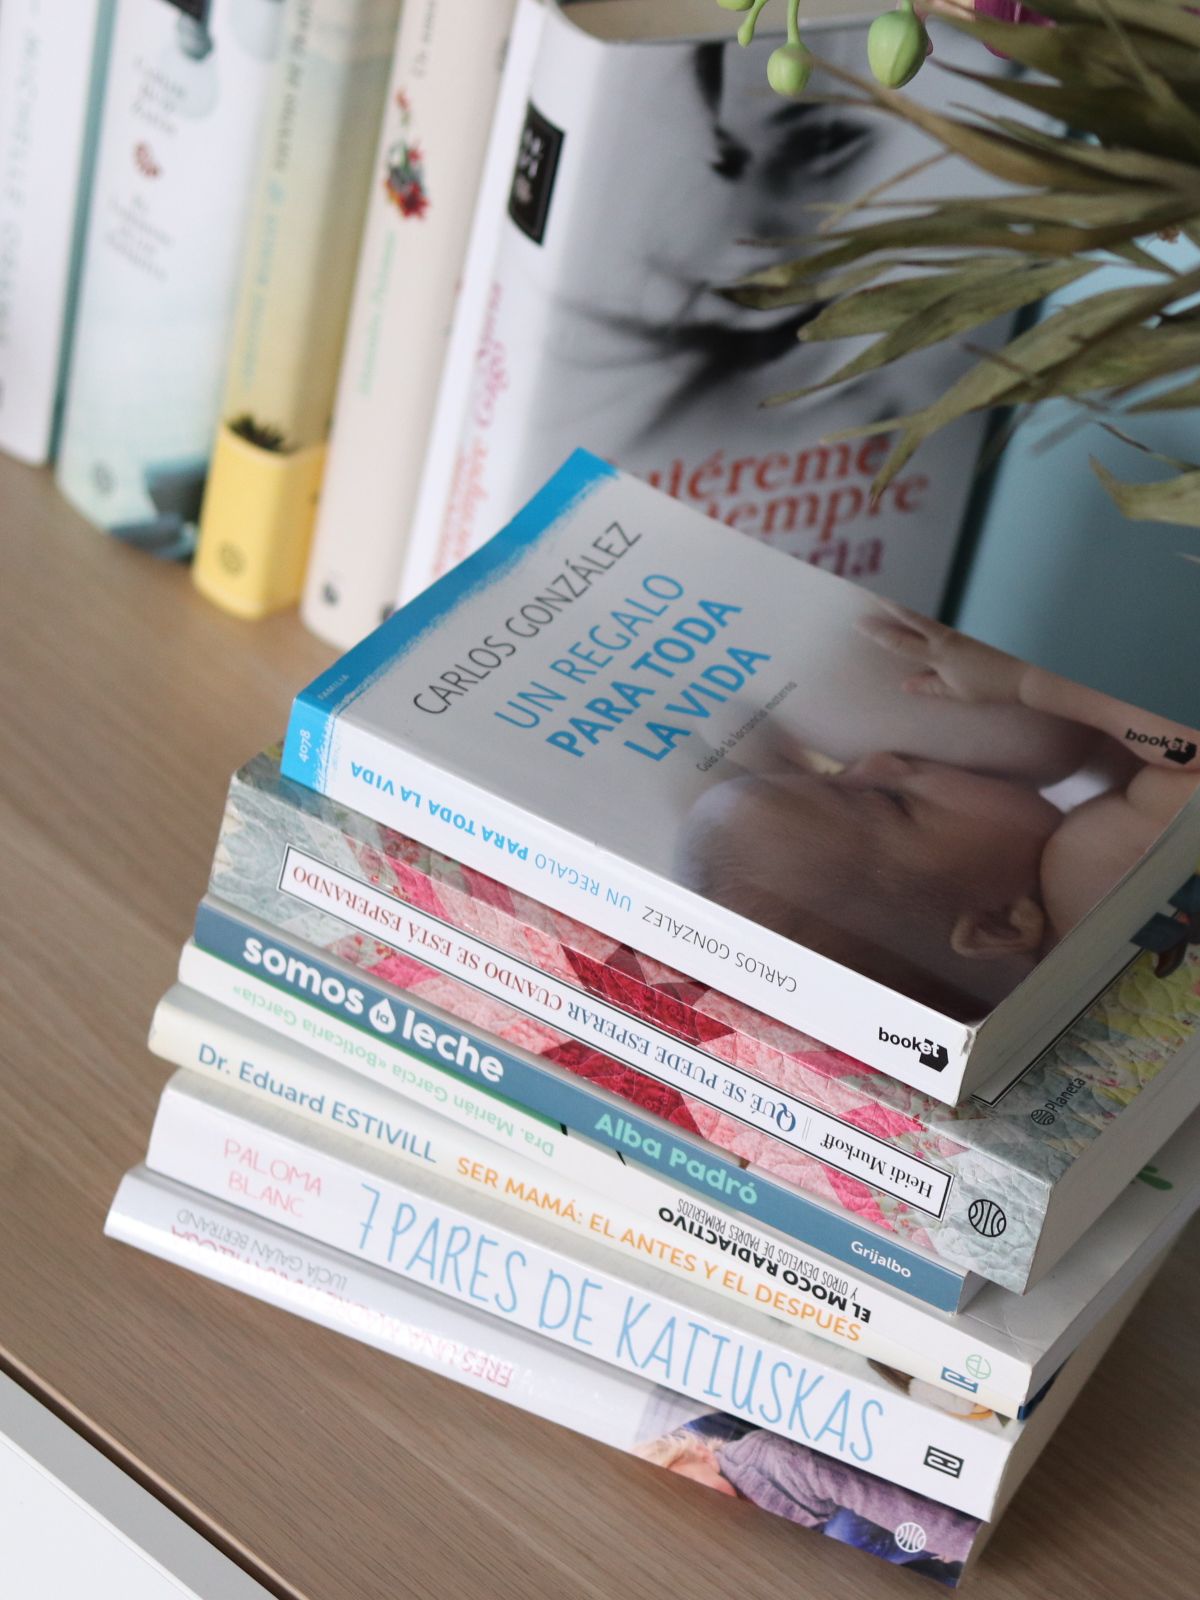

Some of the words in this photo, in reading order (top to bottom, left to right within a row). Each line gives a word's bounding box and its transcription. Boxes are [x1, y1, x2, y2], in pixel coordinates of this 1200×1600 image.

[413, 634, 517, 715] CARLOS
[505, 522, 642, 639] GONZÁLEZ
[494, 681, 568, 729] UN
[552, 574, 685, 685] REGALO
[545, 675, 656, 758] PARA
[634, 598, 743, 678] TODA
[624, 709, 691, 762] LA
[679, 644, 771, 718] VIDA
[299, 730, 312, 762] 4078
[713, 746, 725, 759] de
[721, 736, 736, 751] la
[1124, 728, 1192, 755] booket
[350, 761, 395, 795] VIDA
[400, 786, 421, 808] LA
[428, 800, 476, 837] TODA
[482, 830, 529, 861] PARA
[535, 853, 600, 896] REGALO
[293, 865, 402, 931] ESPERANDO
[607, 889, 631, 912] UN
[409, 920, 452, 957] ESTÁ
[642, 905, 730, 961] GONZÁLEZ
[457, 950, 480, 971] SE
[736, 951, 798, 993] CARLOS
[484, 961, 562, 1011] CUANDO
[242, 936, 364, 1015] somos
[376, 1008, 389, 1024] la
[403, 1011, 504, 1082] leche
[567, 1002, 651, 1055] ESPERAR
[878, 1026, 941, 1059] booket
[656, 1046, 718, 1090] PUEDE
[198, 1043, 230, 1075] Dr.
[239, 1062, 325, 1113] Eduard
[330, 1102, 437, 1163] ESTIVILL
[724, 1079, 748, 1104] SE
[1047, 1075, 1086, 1113] Planeta
[453, 1094, 514, 1135] Marián
[520, 1127, 555, 1158] Dra.
[593, 1112, 664, 1157] Alba
[669, 1144, 758, 1206] Padró
[820, 1133, 884, 1176] Murkoff
[223, 1138, 323, 1196] PALOMA
[888, 1162, 933, 1200] Heidi
[228, 1173, 304, 1219] BLANC
[678, 1197, 727, 1232] PRIMERIZOS
[177, 1208, 250, 1250] BERTRAND
[457, 1157, 498, 1188] SER
[504, 1178, 583, 1225] MAMÁ:
[589, 1214, 616, 1239] EL
[618, 1228, 697, 1274] ANTES
[703, 1262, 719, 1281] Y
[722, 1273, 750, 1299] EL
[755, 1286, 862, 1340] DESPUÉS
[659, 1206, 780, 1278] RADIACTIVO
[725, 1223, 761, 1250] PADRES
[759, 1240, 776, 1257] DE
[250, 1236, 301, 1272] GALÁN
[776, 1249, 820, 1279] DESVELOS
[849, 1239, 912, 1278] Grijalbo
[299, 1257, 349, 1291] LUCÍA
[782, 1267, 849, 1310] MOCO
[818, 1270, 850, 1295] OTROS
[848, 1286, 860, 1300] Y
[358, 1183, 380, 1250] 7
[387, 1203, 527, 1314] PARES
[539, 1269, 602, 1346] DE
[616, 1295, 884, 1463] KATIUSKAS
[846, 1298, 871, 1323] EL
[458, 1348, 515, 1388] ERES
